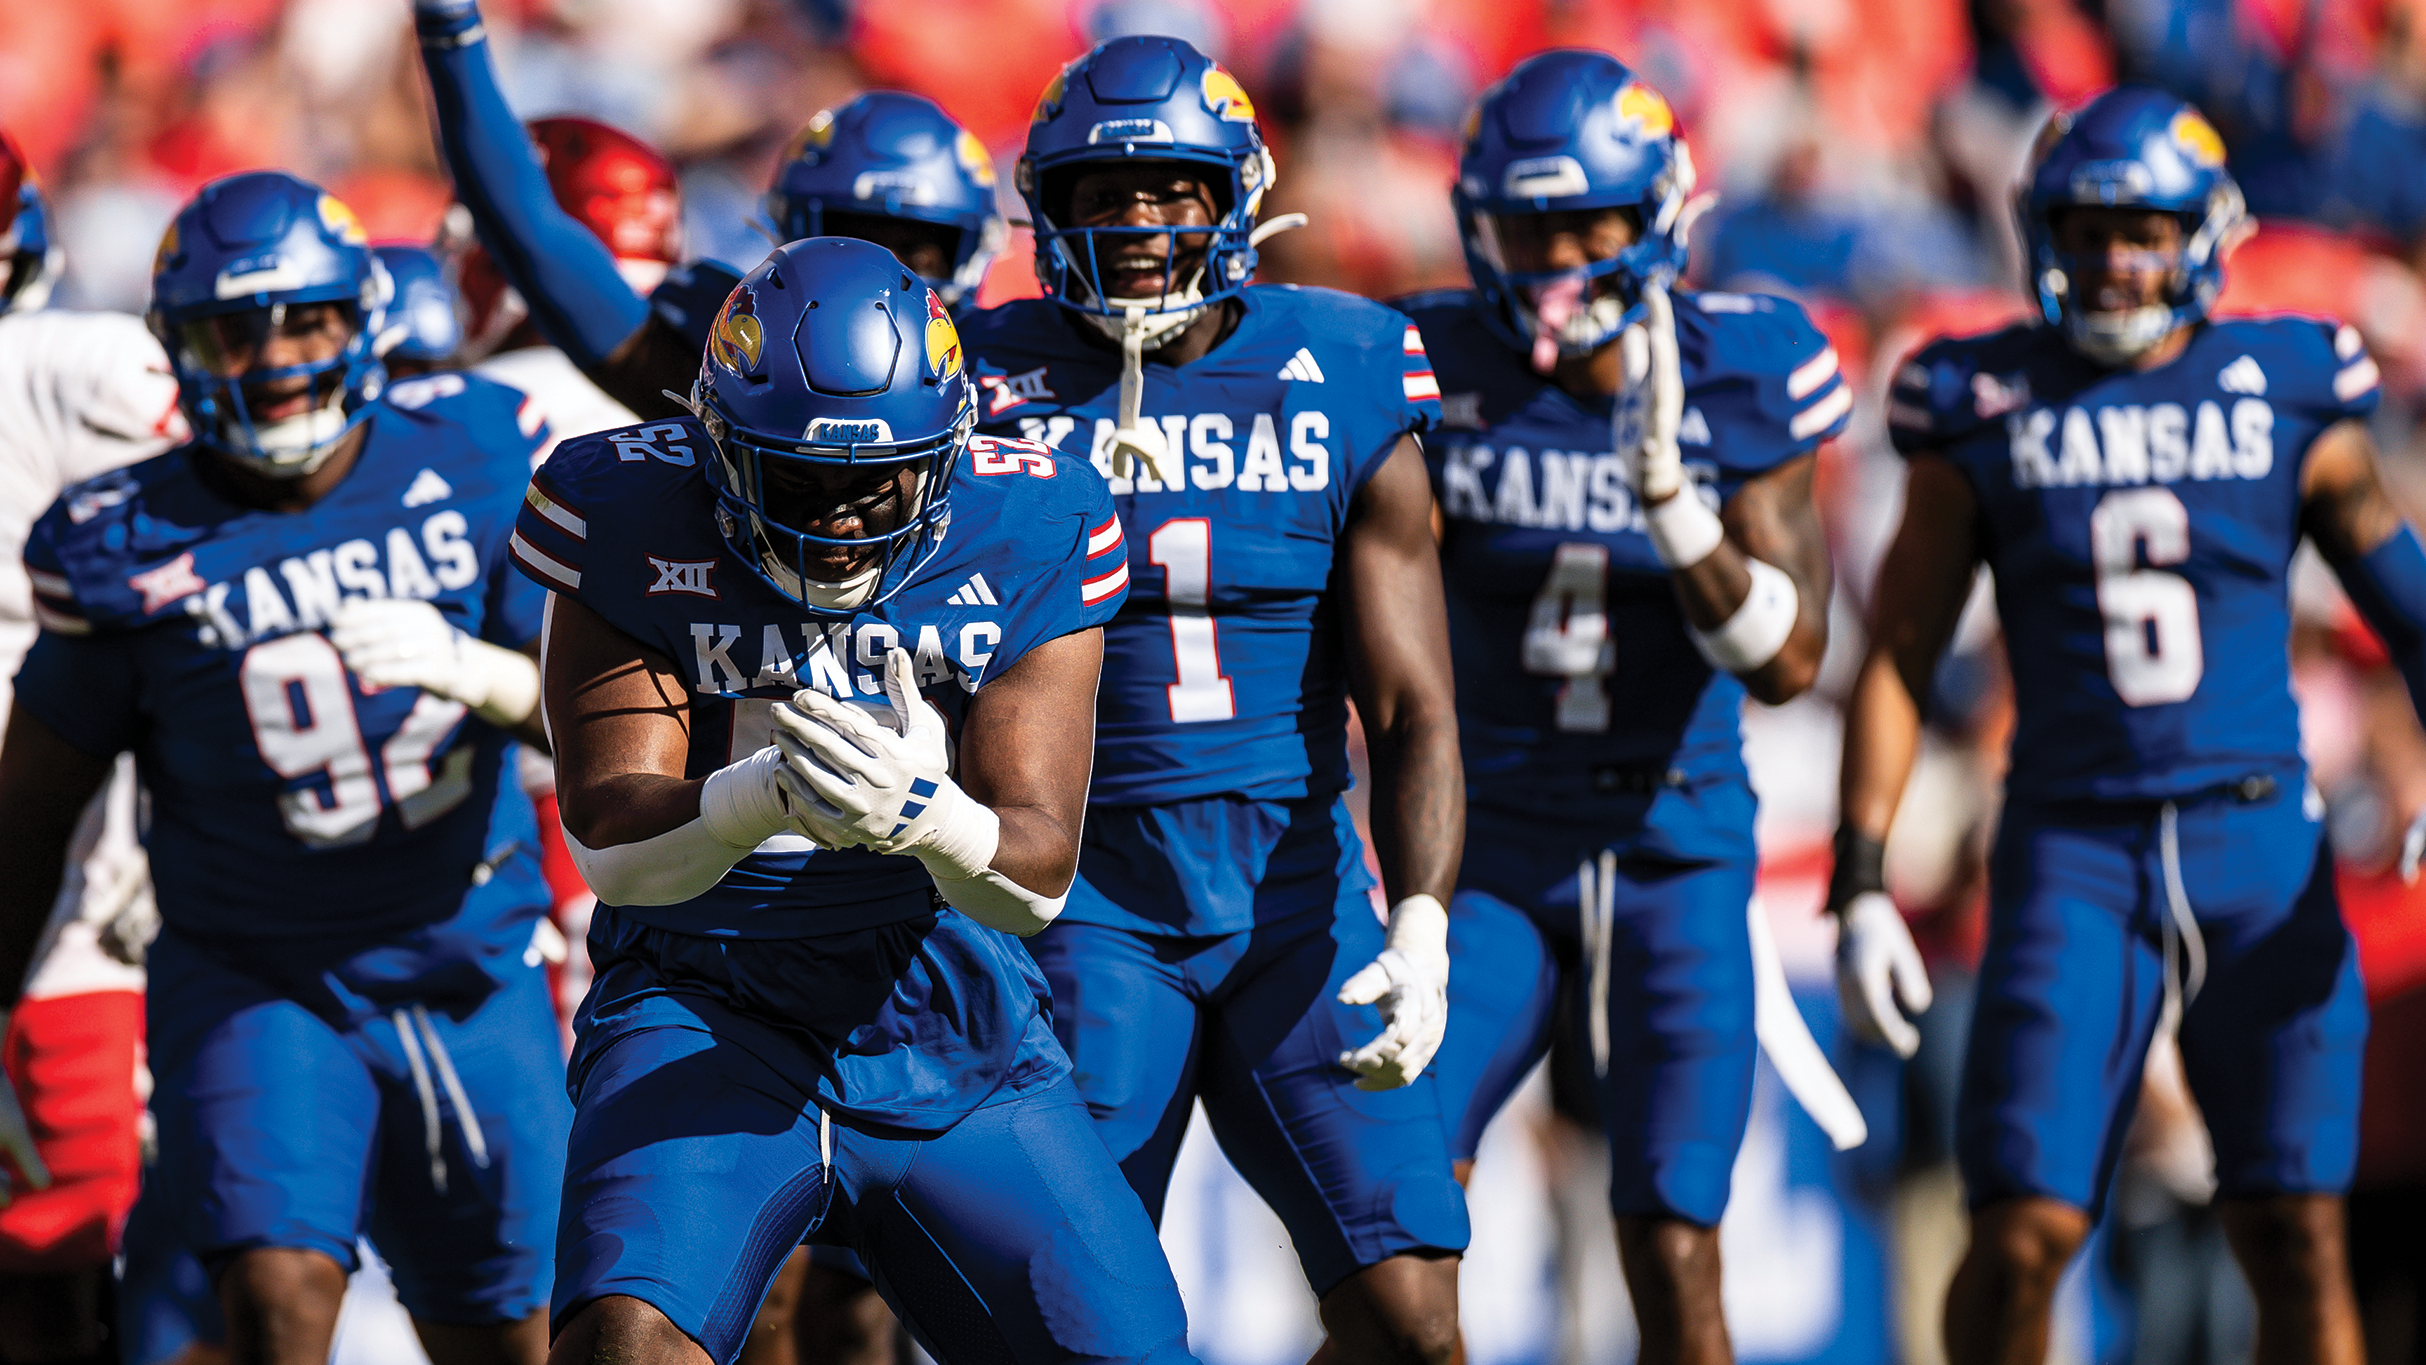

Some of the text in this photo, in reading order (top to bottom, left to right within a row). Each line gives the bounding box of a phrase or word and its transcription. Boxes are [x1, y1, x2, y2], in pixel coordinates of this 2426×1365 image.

[604, 423, 697, 469] 52
[820, 423, 879, 440] KANSAS
[967, 435, 1057, 479] 52
[2009, 399, 2274, 488] KANSAS
[1443, 444, 1722, 534] KANS
[184, 509, 480, 651] KANSAS
[643, 551, 722, 601] XII
[1149, 516, 1236, 723] 1
[2091, 486, 2203, 707] 6
[690, 621, 1001, 698] KANSAS
[1521, 542, 1616, 731] 4
[238, 630, 475, 849] 92
